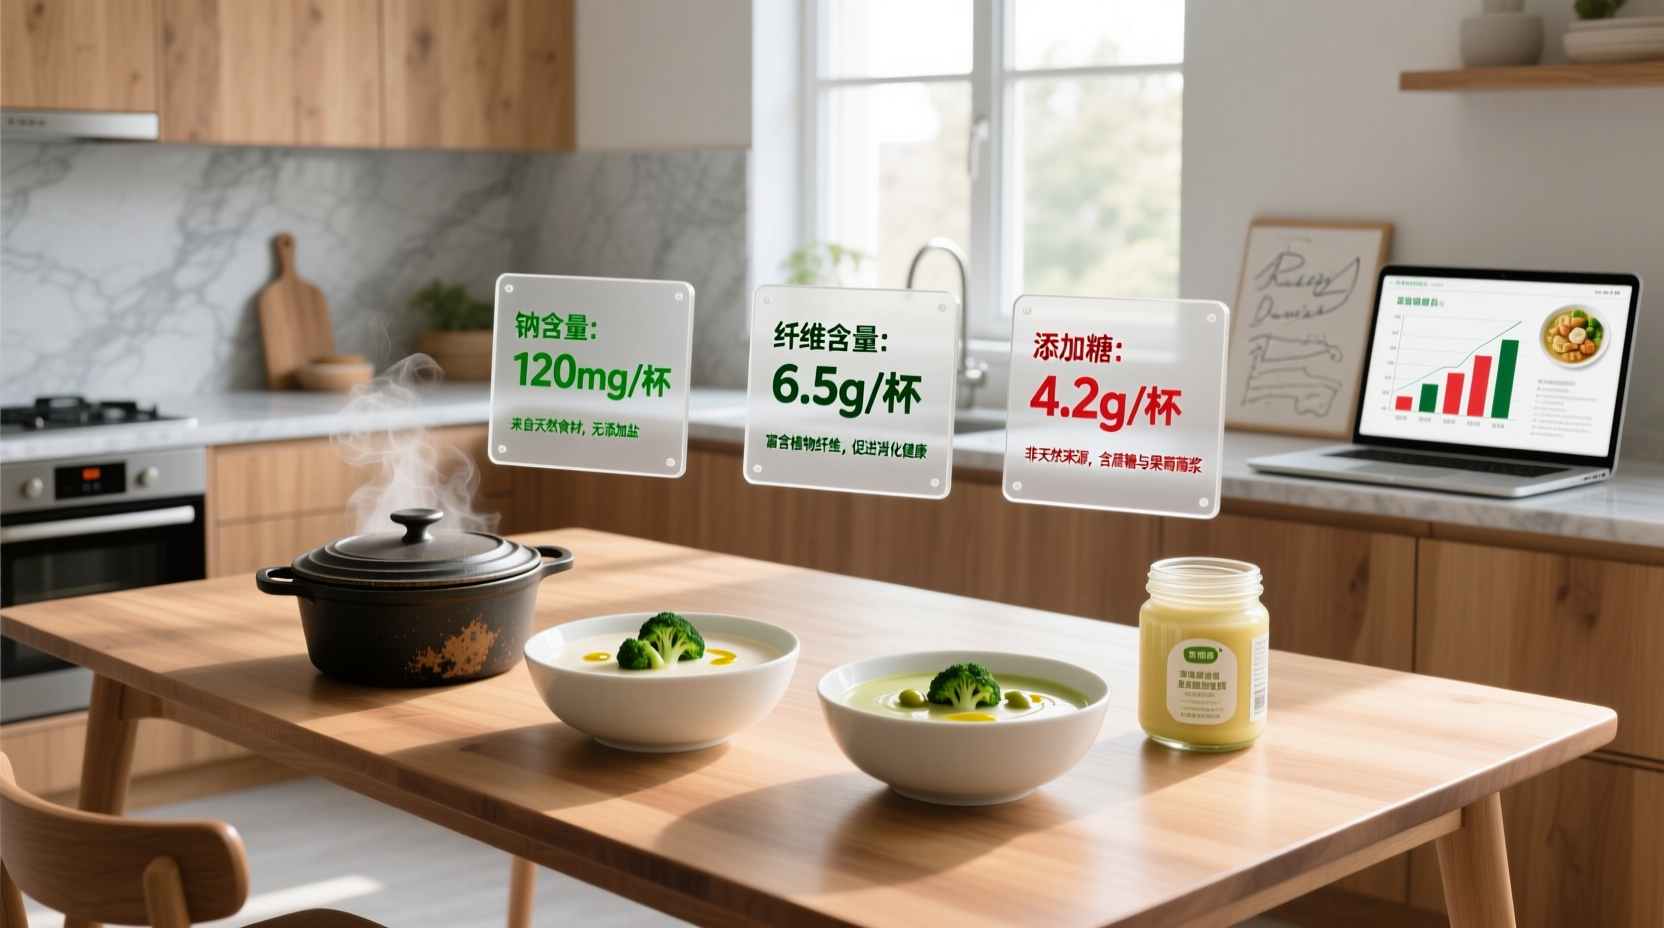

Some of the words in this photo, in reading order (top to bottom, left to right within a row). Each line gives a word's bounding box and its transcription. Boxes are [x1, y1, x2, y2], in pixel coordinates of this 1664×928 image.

[513, 351, 672, 401] 120mg/杯
[772, 363, 922, 418] 6.5g/杯
[1029, 375, 1182, 432] 4.2g/杯
